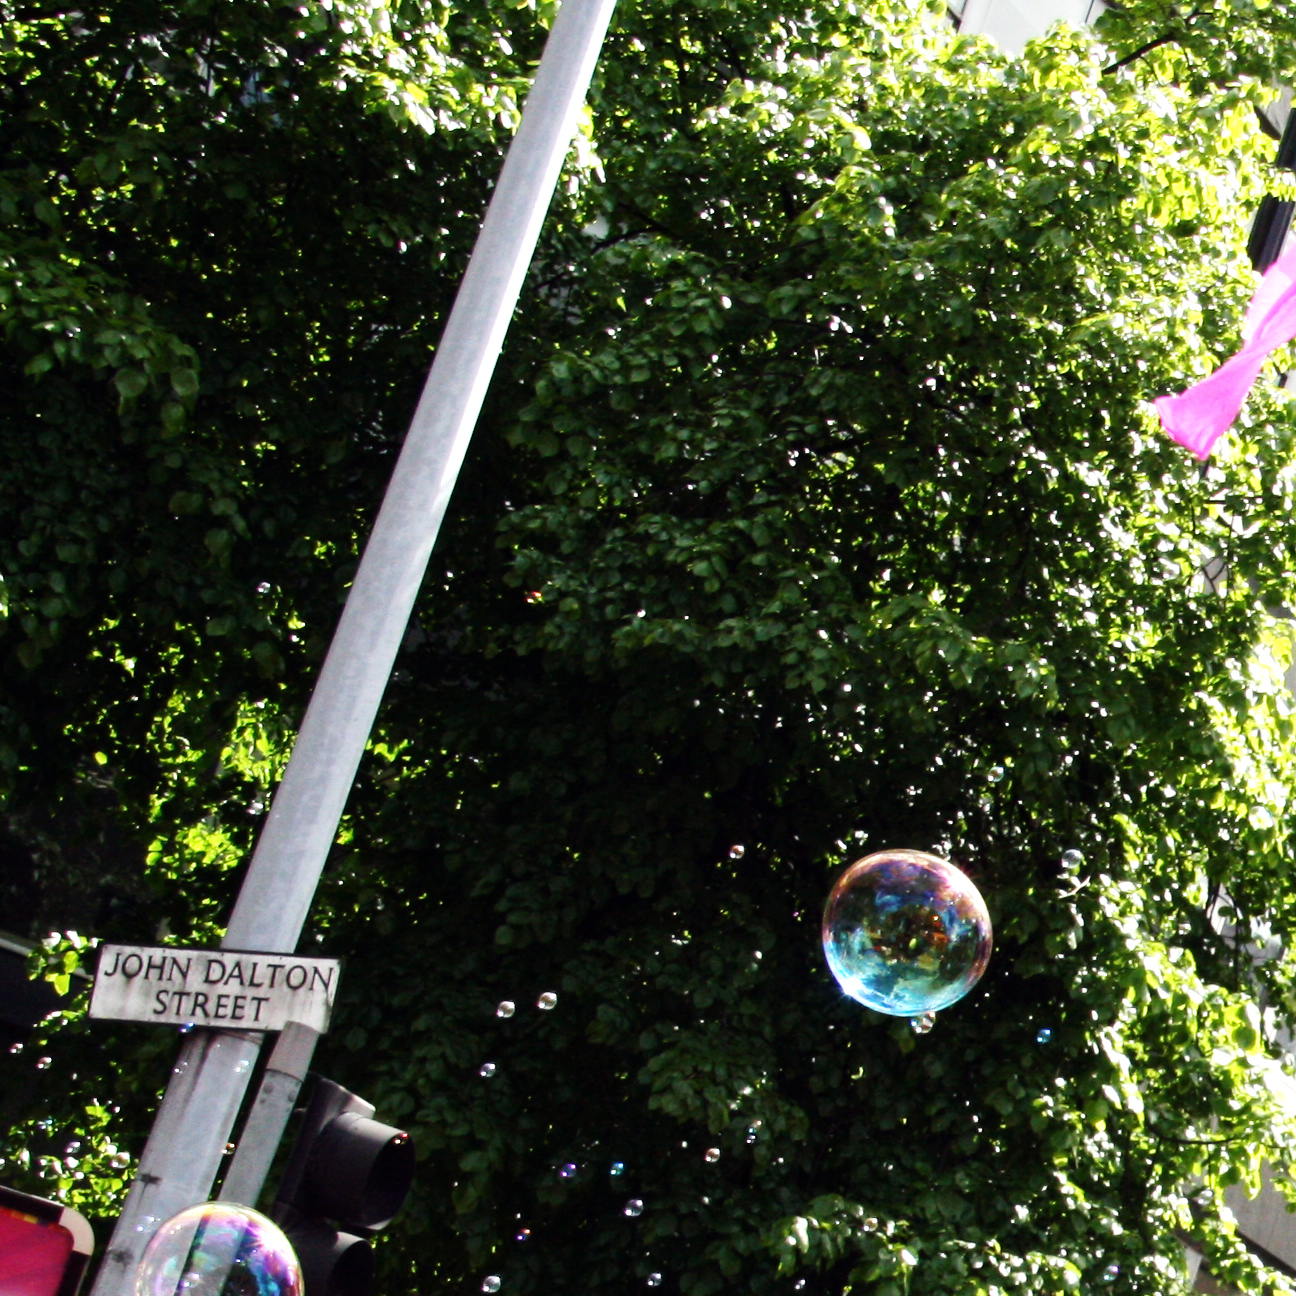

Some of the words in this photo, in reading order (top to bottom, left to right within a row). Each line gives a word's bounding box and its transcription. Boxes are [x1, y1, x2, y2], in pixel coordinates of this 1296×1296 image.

[104, 952, 191, 982] JOHN
[204, 958, 334, 992] DALTON
[153, 989, 269, 1022] STREET
